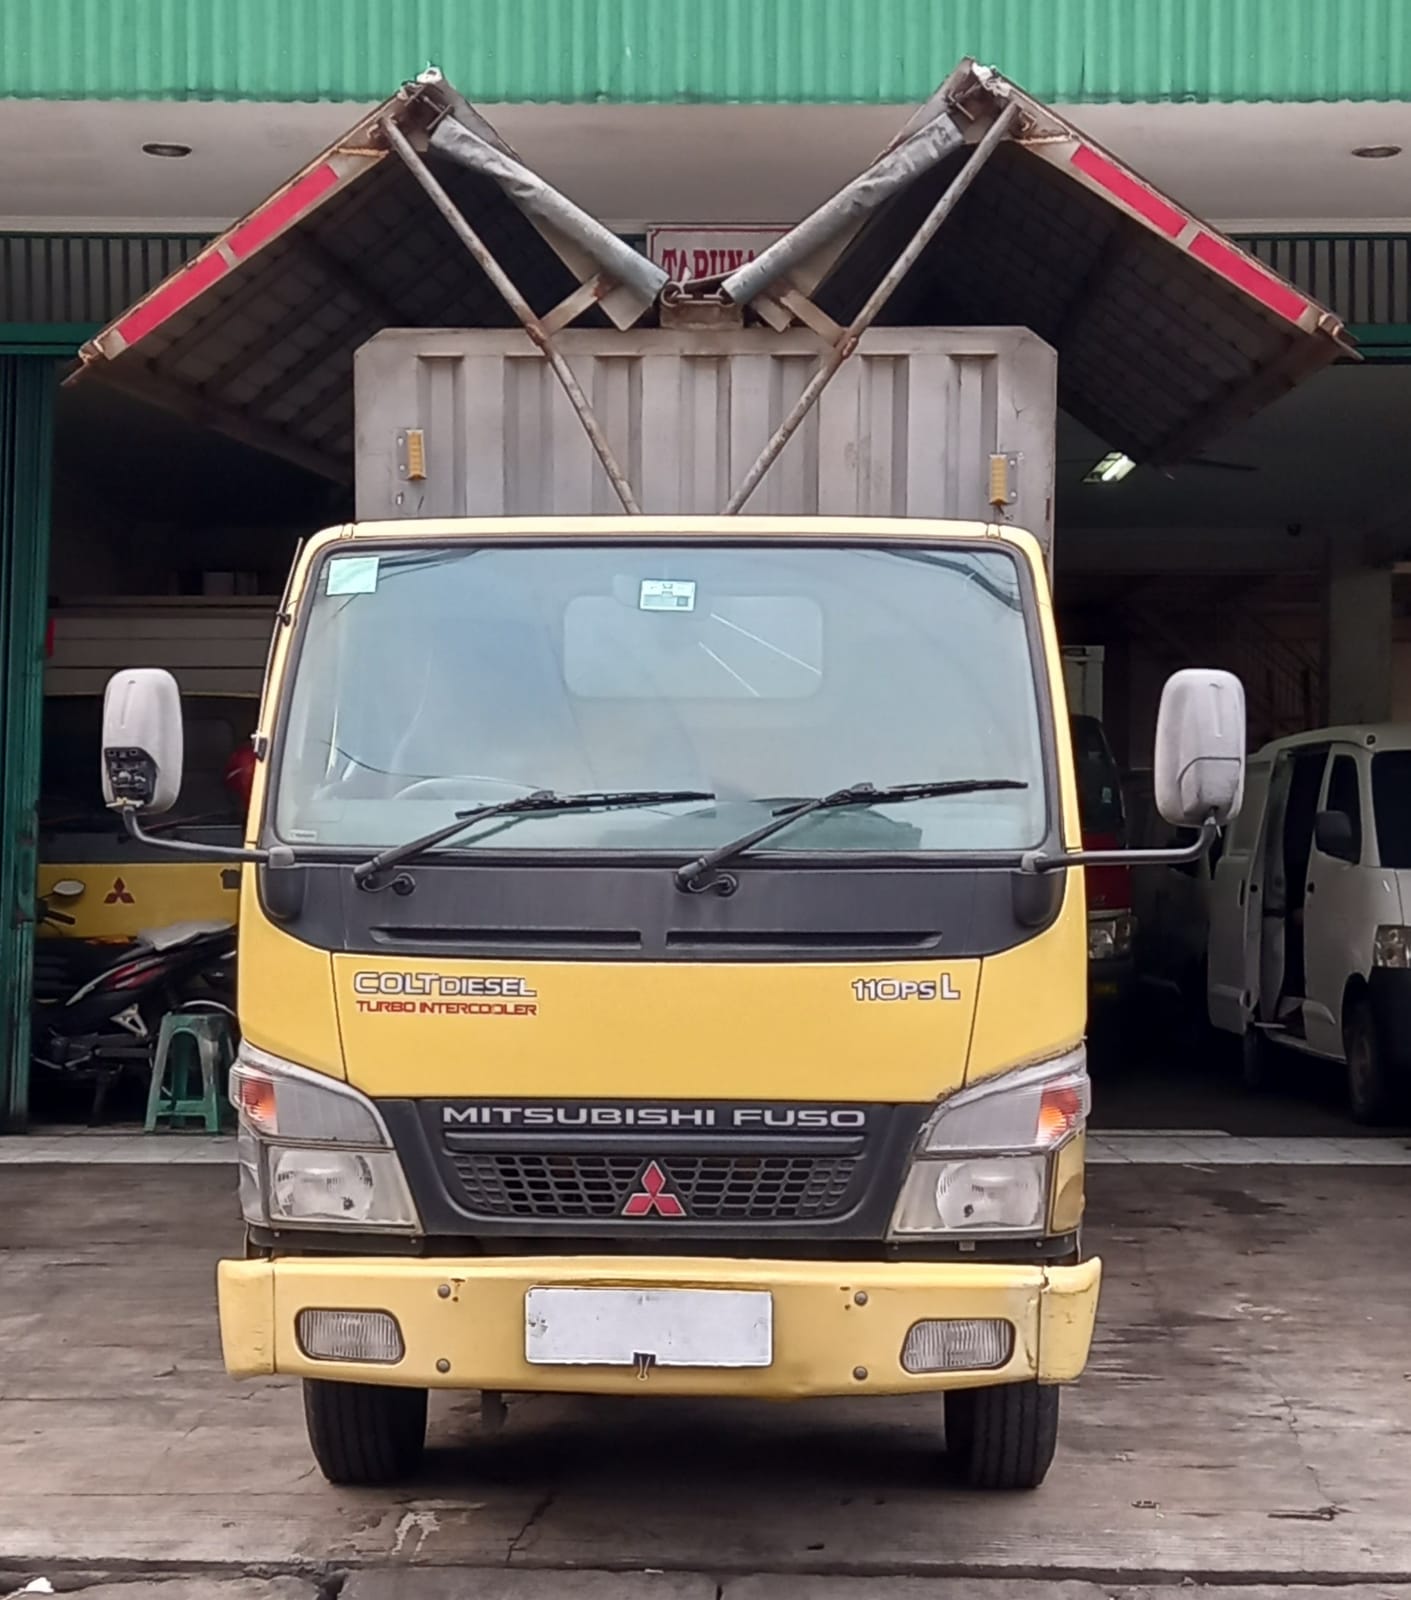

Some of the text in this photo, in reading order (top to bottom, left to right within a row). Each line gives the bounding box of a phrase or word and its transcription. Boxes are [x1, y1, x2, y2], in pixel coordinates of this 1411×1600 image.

[356, 1000, 537, 1016] TURBO INTERCOOLER
[443, 1107, 866, 1127] MITSUBISHI FUSO
